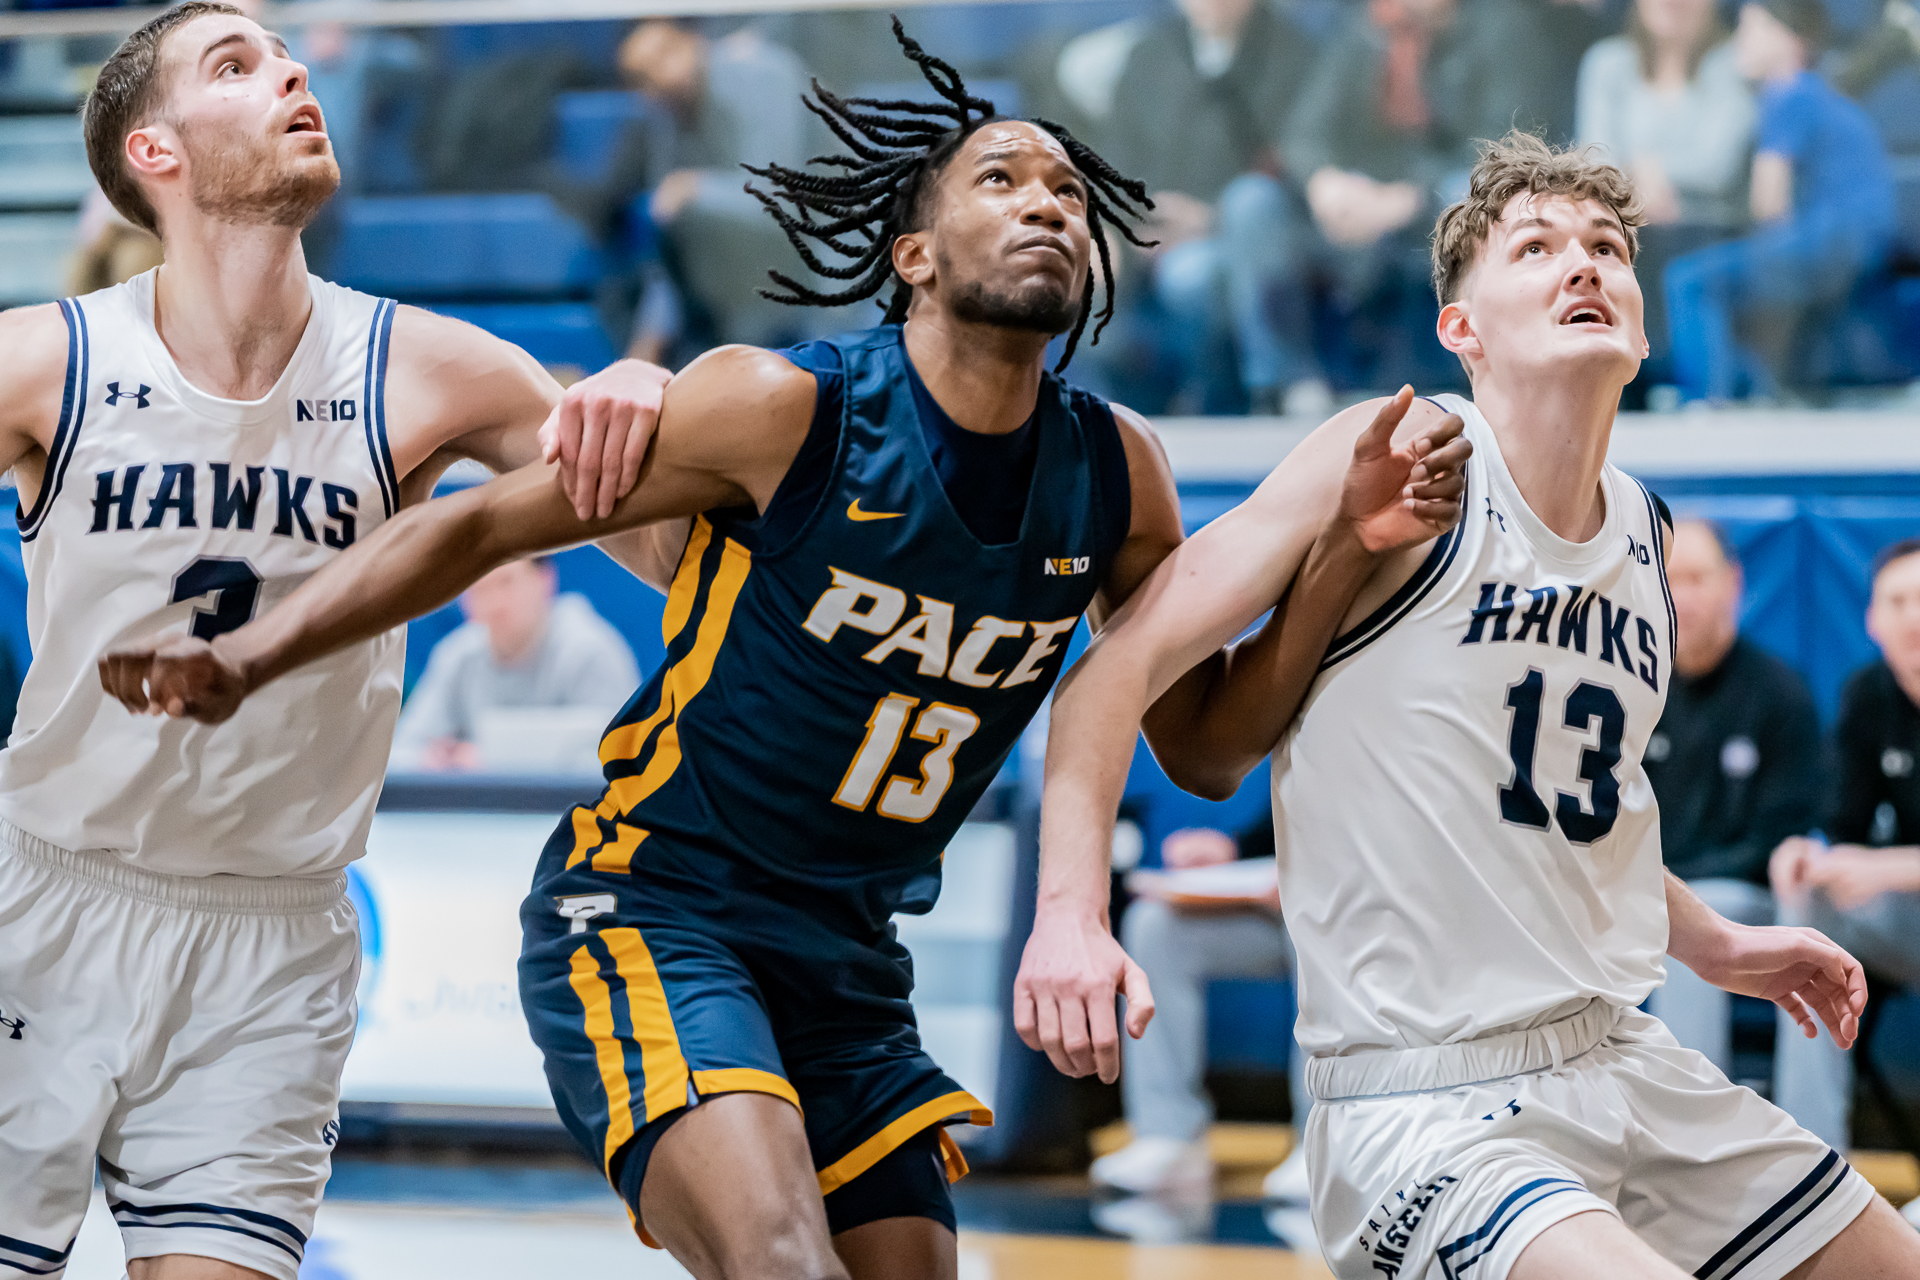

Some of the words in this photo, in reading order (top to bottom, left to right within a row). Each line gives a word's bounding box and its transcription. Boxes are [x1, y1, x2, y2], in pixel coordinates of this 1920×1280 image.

[297, 399, 356, 422] NE10
[85, 461, 360, 551] HAWKS
[1045, 556, 1090, 575] NE10
[802, 565, 1079, 689] PACE
[1457, 581, 1659, 695] HAWKS
[831, 691, 981, 823] 13
[1497, 665, 1628, 848] 13
